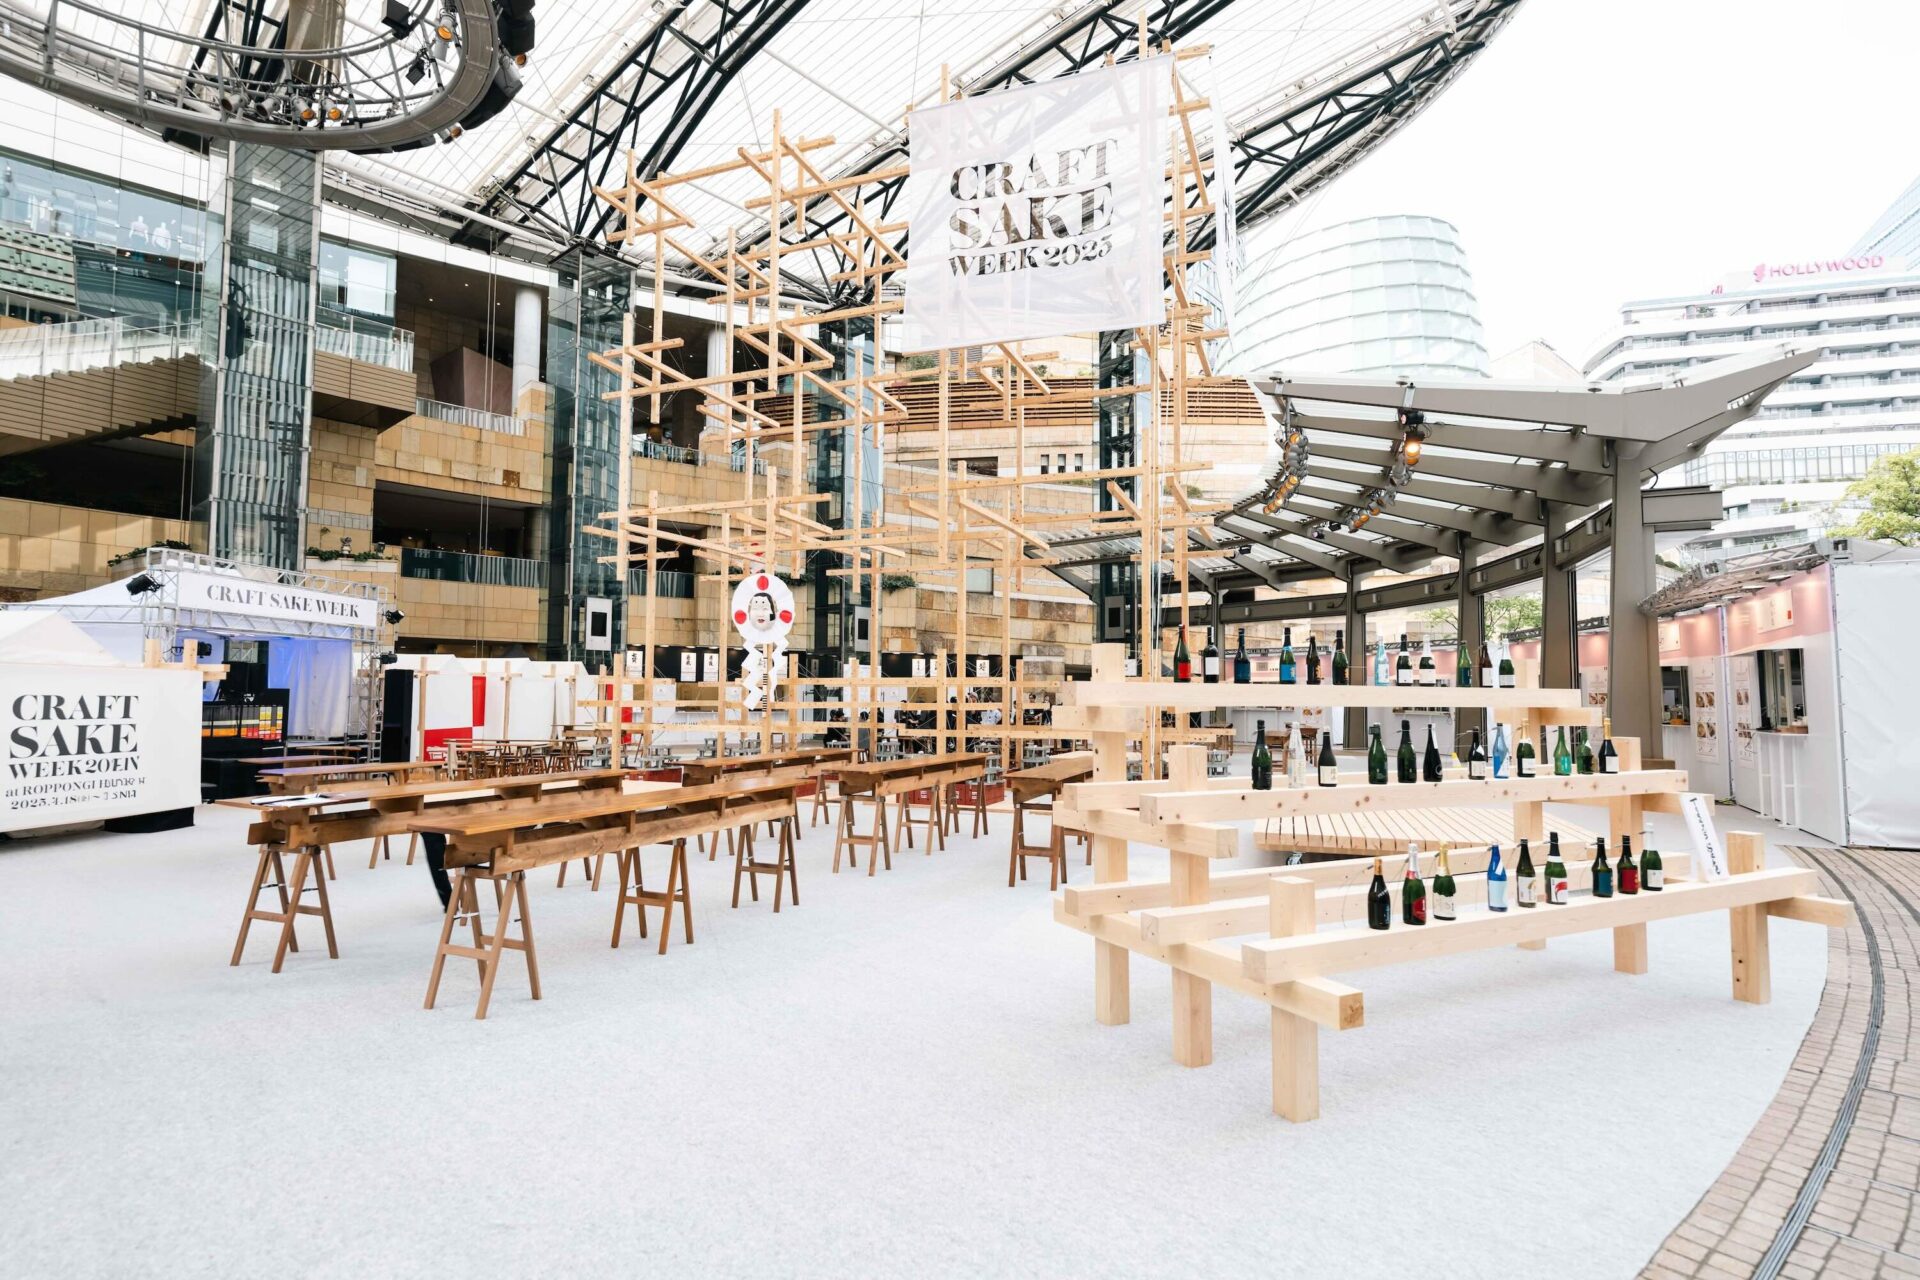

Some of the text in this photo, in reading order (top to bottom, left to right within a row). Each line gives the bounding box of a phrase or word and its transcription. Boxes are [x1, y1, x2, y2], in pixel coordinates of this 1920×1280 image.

[949, 138, 1118, 201] CRAFT
[949, 181, 1115, 250] SAKE
[1770, 256, 1883, 277] HOLLYWOOD
[206, 583, 360, 619] CRAFT SAKE WEEK
[12, 694, 139, 720] CRAFT
[9, 723, 139, 759] SAKE
[23, 780, 95, 796] ROPPONGI
